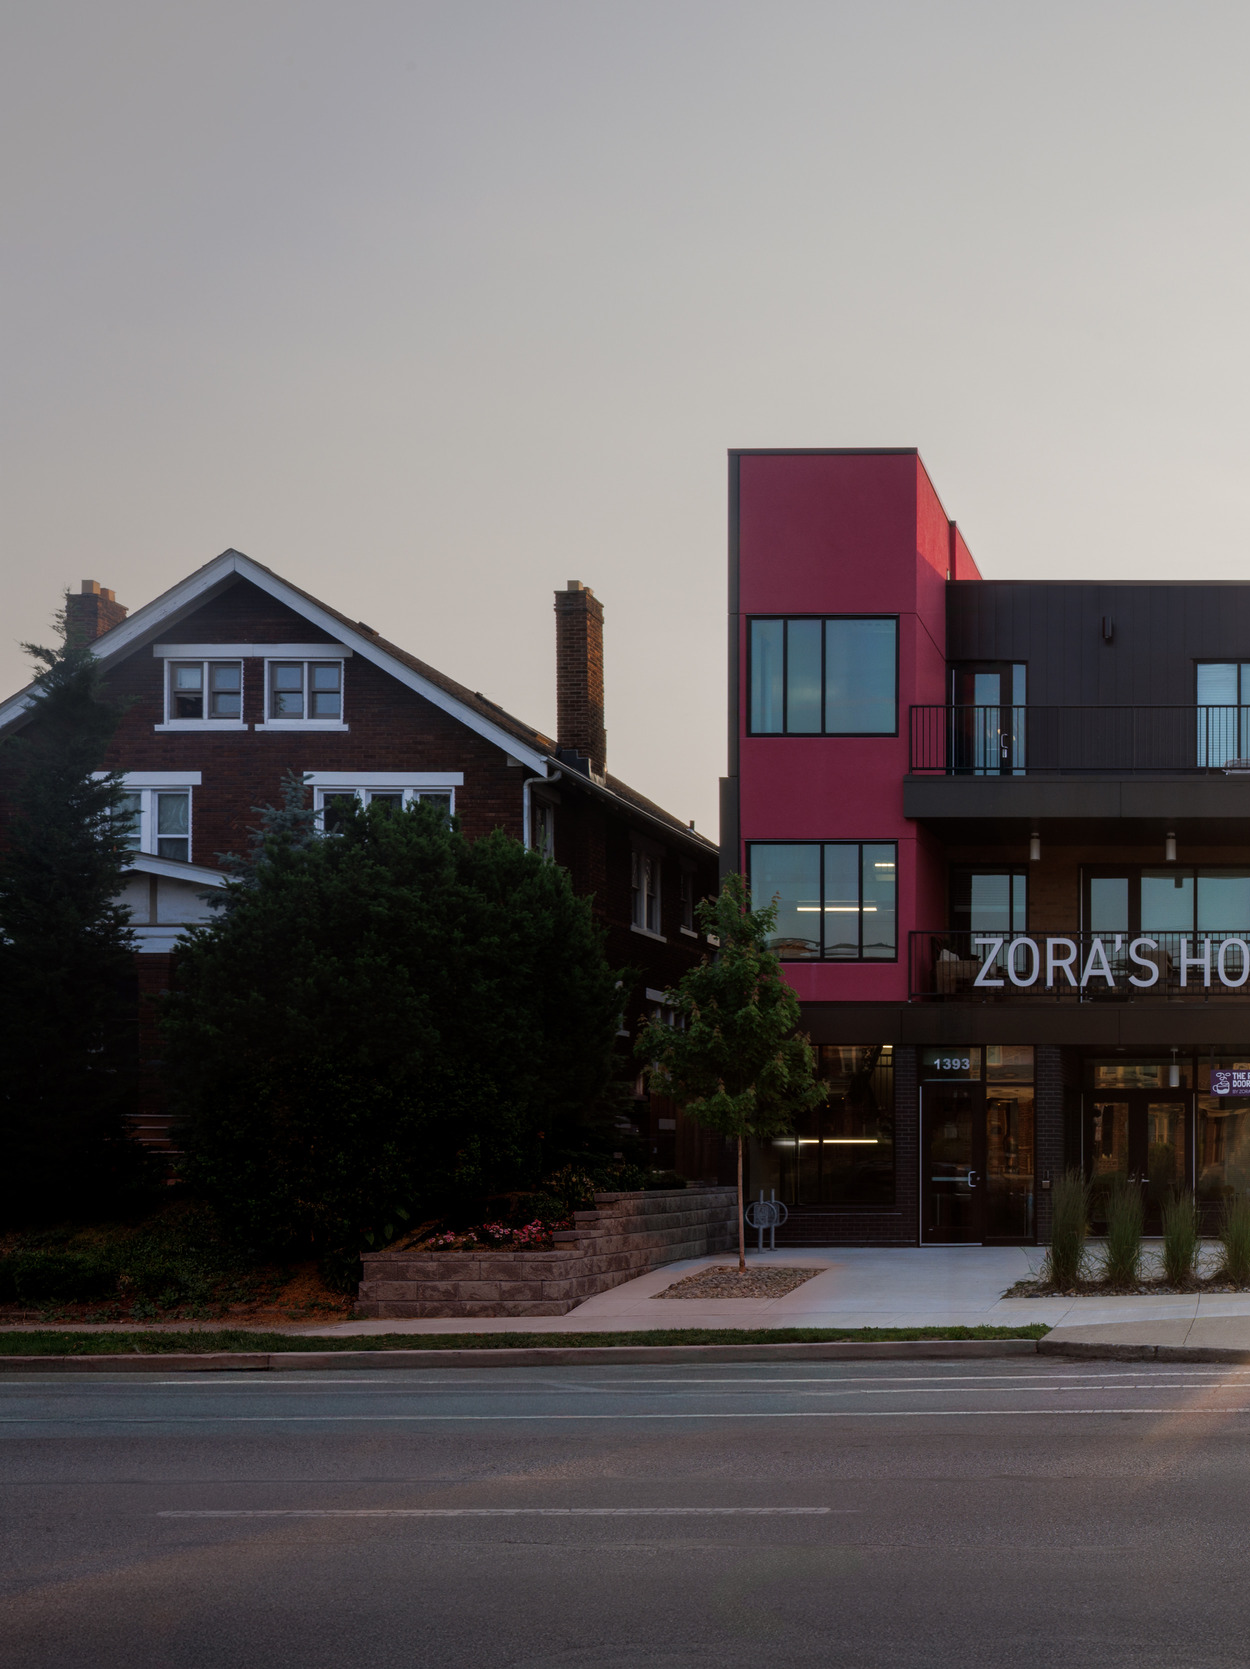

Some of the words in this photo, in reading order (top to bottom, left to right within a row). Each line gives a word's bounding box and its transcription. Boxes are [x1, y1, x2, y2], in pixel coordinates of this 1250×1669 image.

[973, 934, 1160, 988] ZORA'S
[934, 1058, 970, 1070] 1393
[1232, 1072, 1246, 1080] THE
[1232, 1080, 1250, 1088] DOOR
